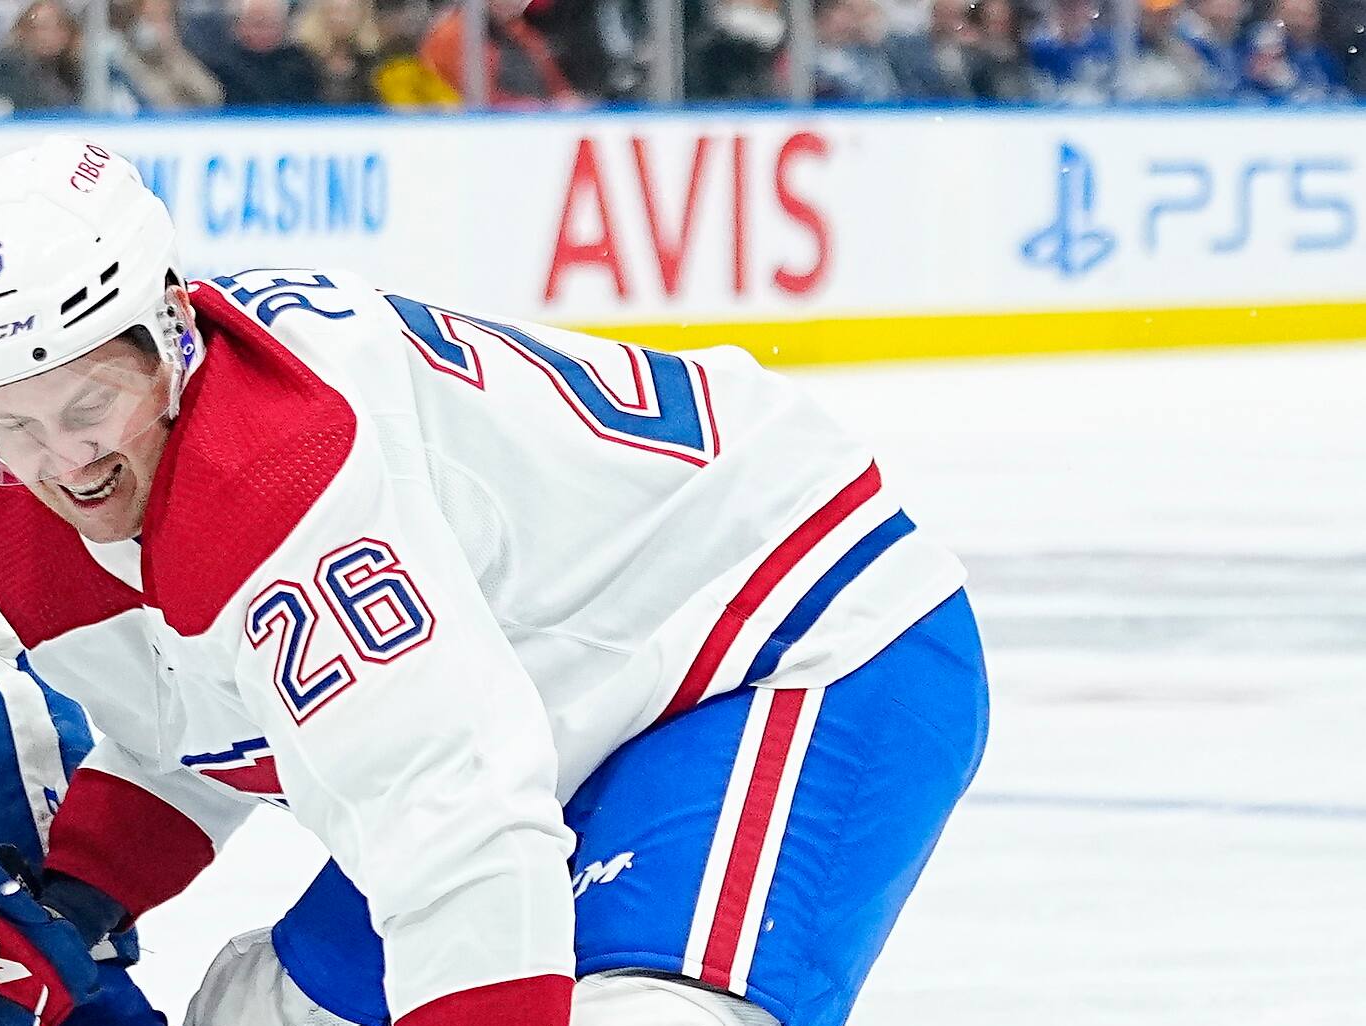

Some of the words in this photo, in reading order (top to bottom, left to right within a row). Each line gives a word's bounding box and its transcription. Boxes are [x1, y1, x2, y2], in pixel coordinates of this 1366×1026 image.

[200, 152, 390, 236] CASINO
[542, 128, 834, 302] AVIS
[1143, 158, 1358, 253] PS5
[244, 536, 437, 726] 26
